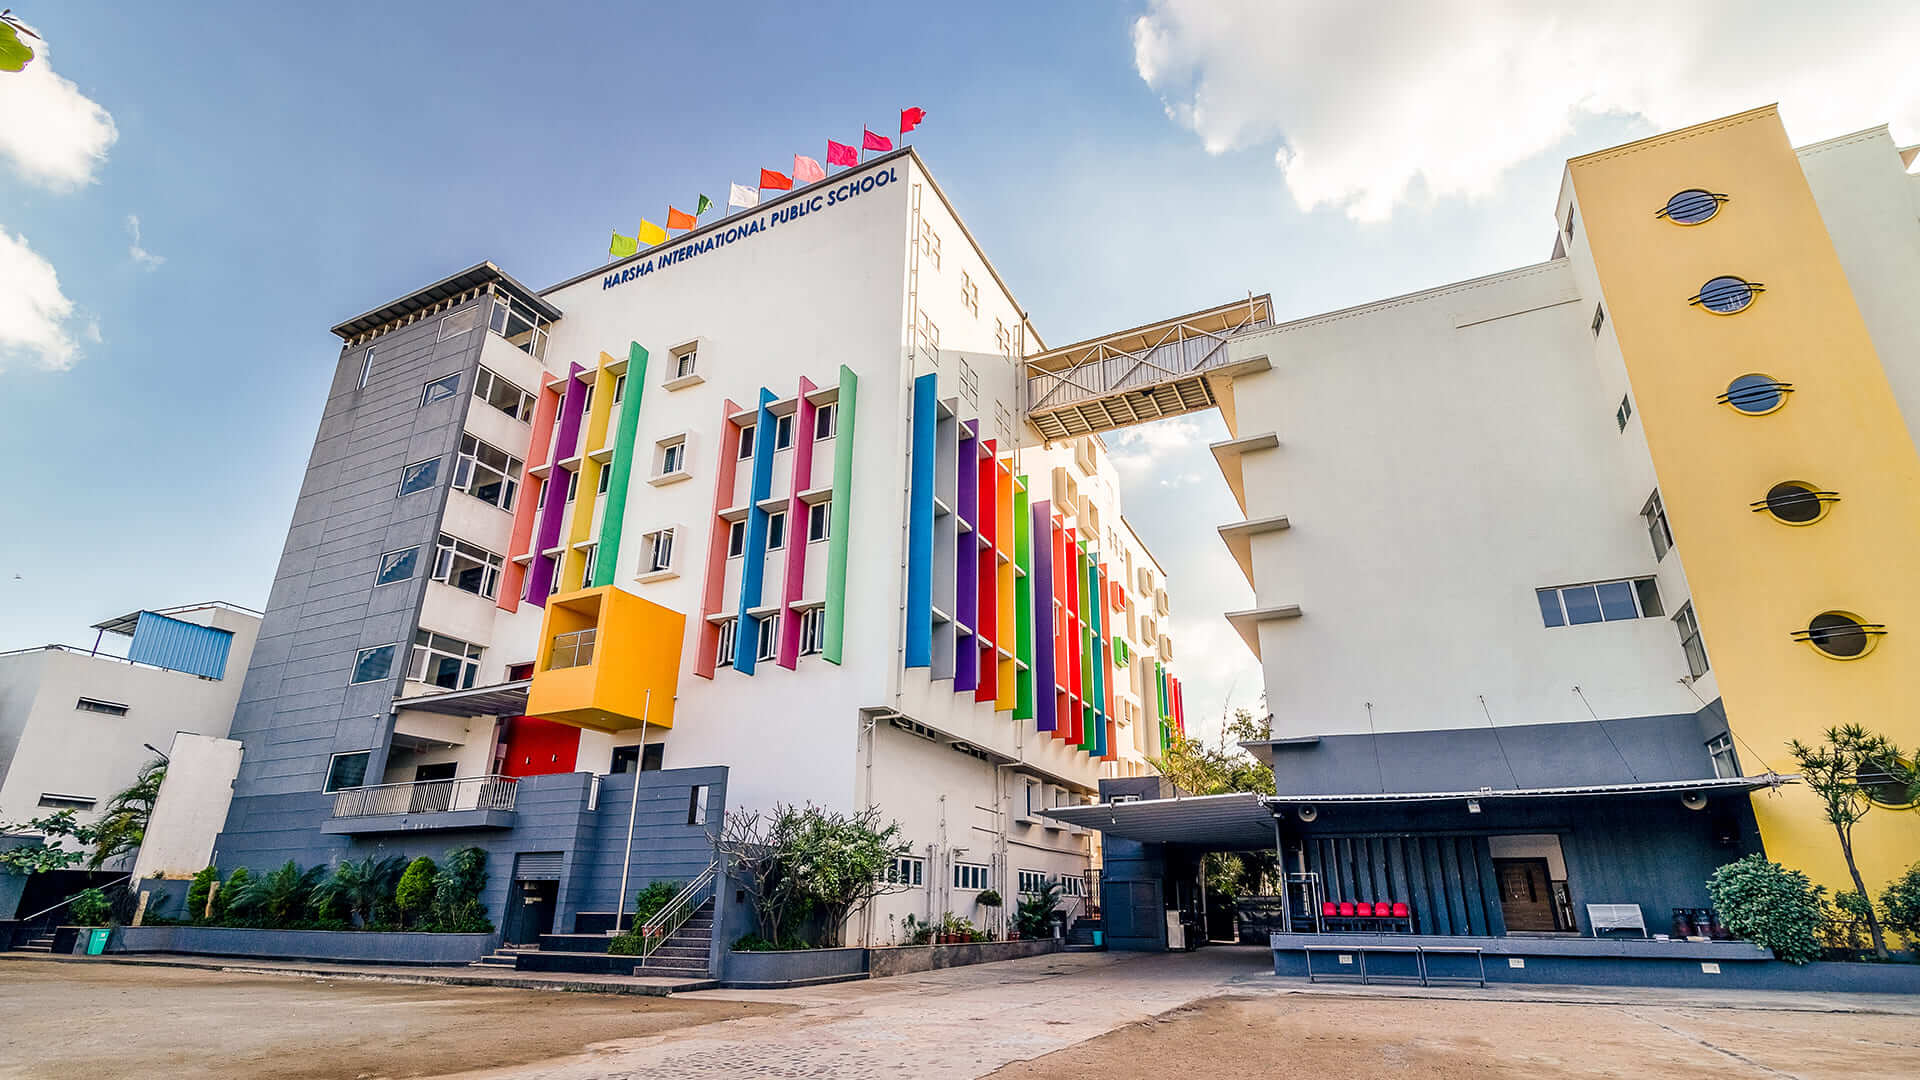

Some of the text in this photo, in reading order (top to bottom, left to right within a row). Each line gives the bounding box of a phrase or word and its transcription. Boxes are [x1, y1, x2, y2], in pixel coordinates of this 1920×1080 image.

[602, 167, 898, 291] HARSHA INTERNATIONAL PUBLIC SCHOOL
